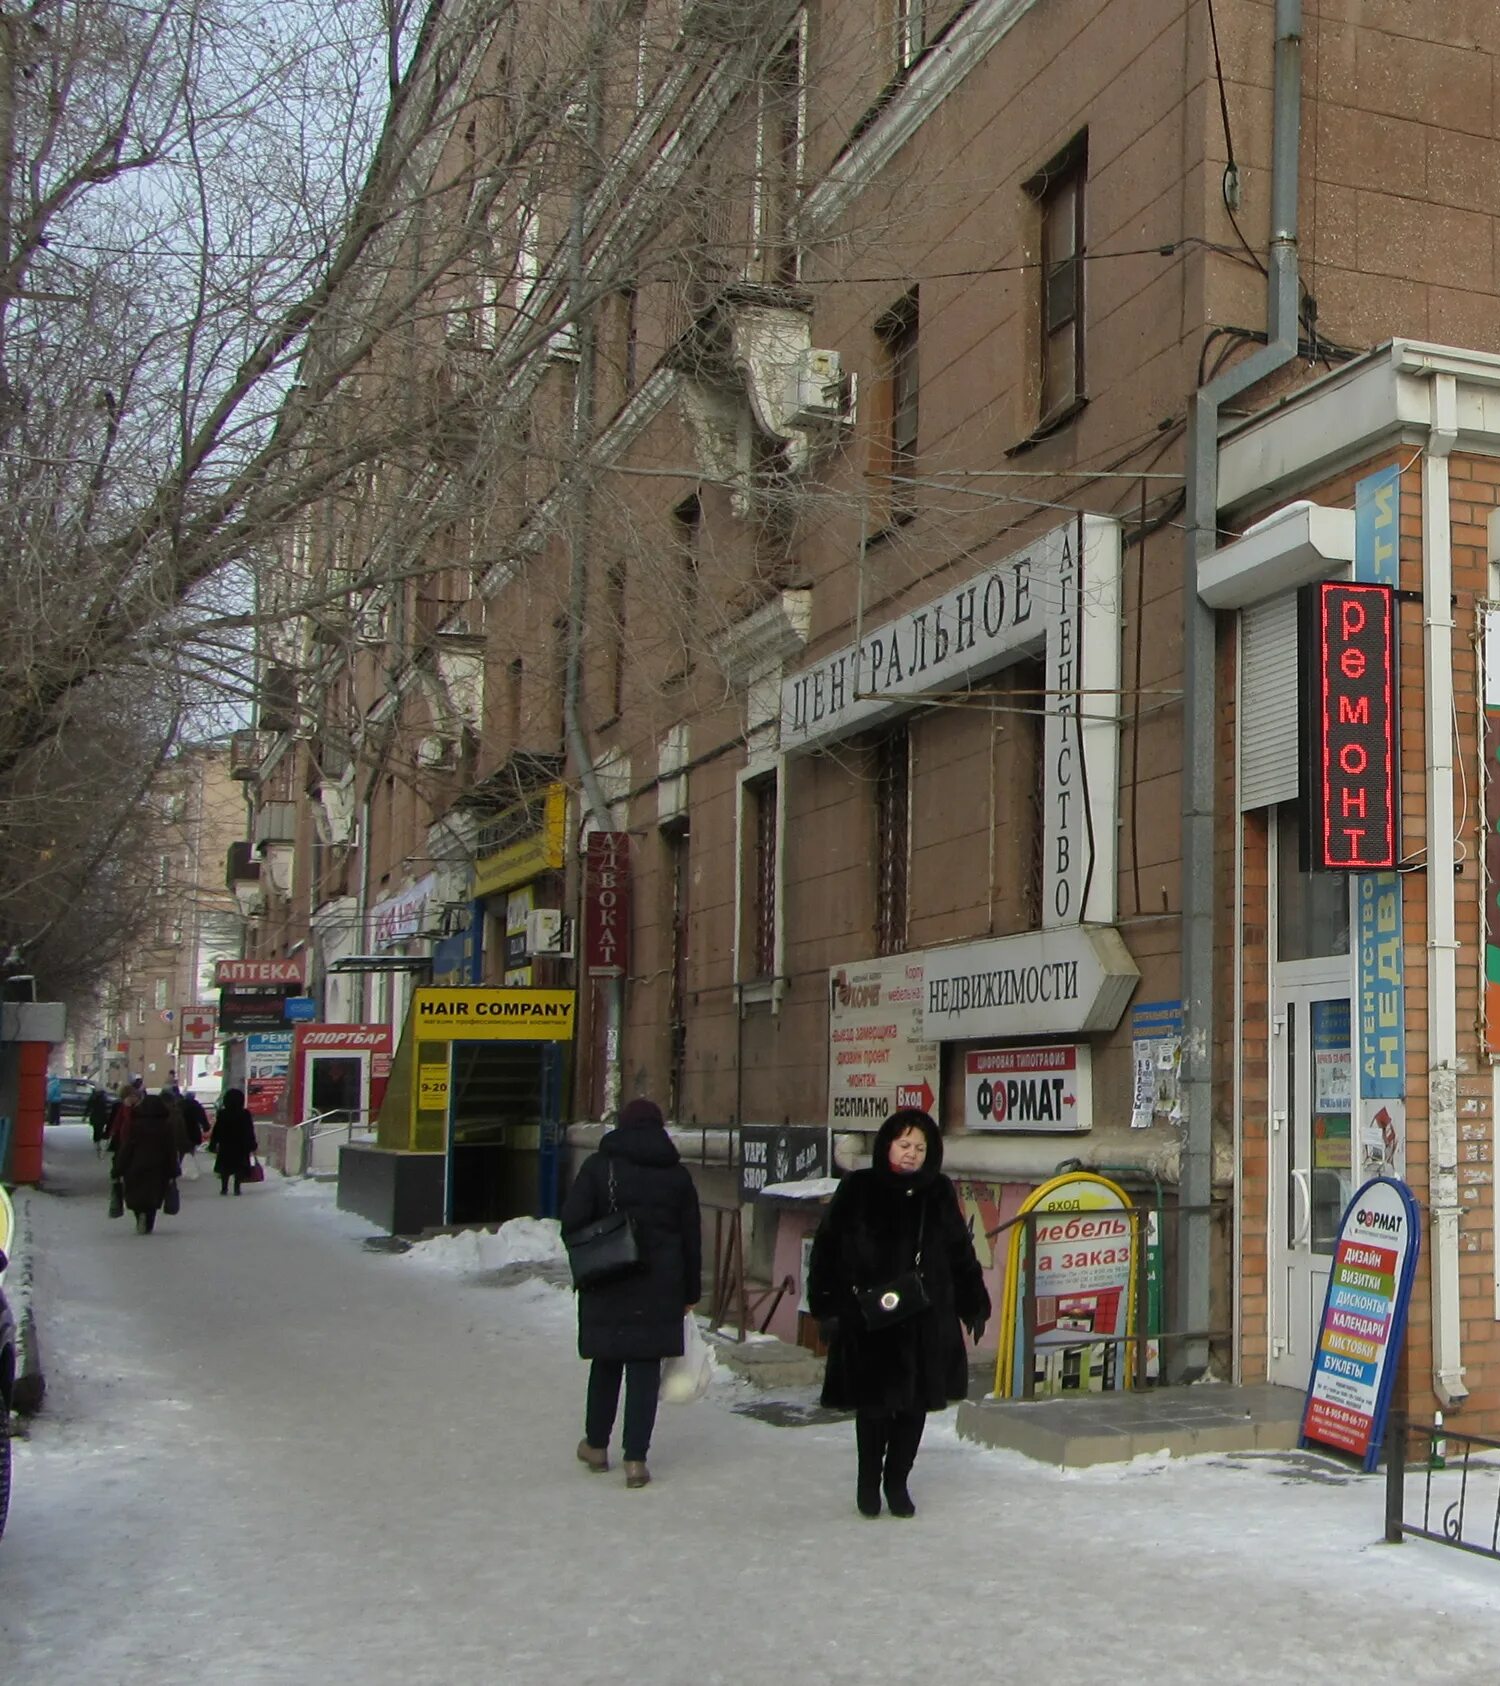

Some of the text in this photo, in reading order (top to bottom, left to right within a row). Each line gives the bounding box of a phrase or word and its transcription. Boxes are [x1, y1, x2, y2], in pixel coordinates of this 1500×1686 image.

[792, 556, 1033, 734] ЦЕНТРАЛЬНОЕ
[1054, 534, 1076, 918] АГЕНТСТВО
[599, 832, 619, 964] АДВОКАТ
[219, 963, 301, 980] АПТЕКА
[1362, 878, 1376, 1078] АГЕНТСТВО
[928, 960, 1080, 1018] НЕДВИЖИМОСТИ
[420, 1002, 572, 1017] HAIR COMPANY
[302, 1031, 387, 1045] СПОРТБАР
[977, 1051, 1066, 1069] ЦИФРОВАЯ ТИПОГРАФИЯ
[421, 1083, 448, 1092] 9-20
[897, 1086, 922, 1108] Вход
[833, 1096, 889, 1119] БЕСПЛАТНО
[977, 1078, 1065, 1122] ФОРМАТ
[744, 1141, 767, 1164] VAPE
[743, 1167, 768, 1190] SHOP
[1356, 1208, 1403, 1233] ФОРМАТ
[1061, 1247, 1130, 1270] заказ
[1343, 1247, 1382, 1268] ДИЗАЙН
[1340, 1269, 1381, 1291] ВИЗИТКИ
[1336, 1290, 1386, 1314] ДИСКОНТЫ
[1332, 1311, 1385, 1338] КАЛЕНДАРИ
[1328, 1334, 1375, 1358] ЛИСТОВКИ
[1324, 1355, 1365, 1378] БУКЛЕТЫ
